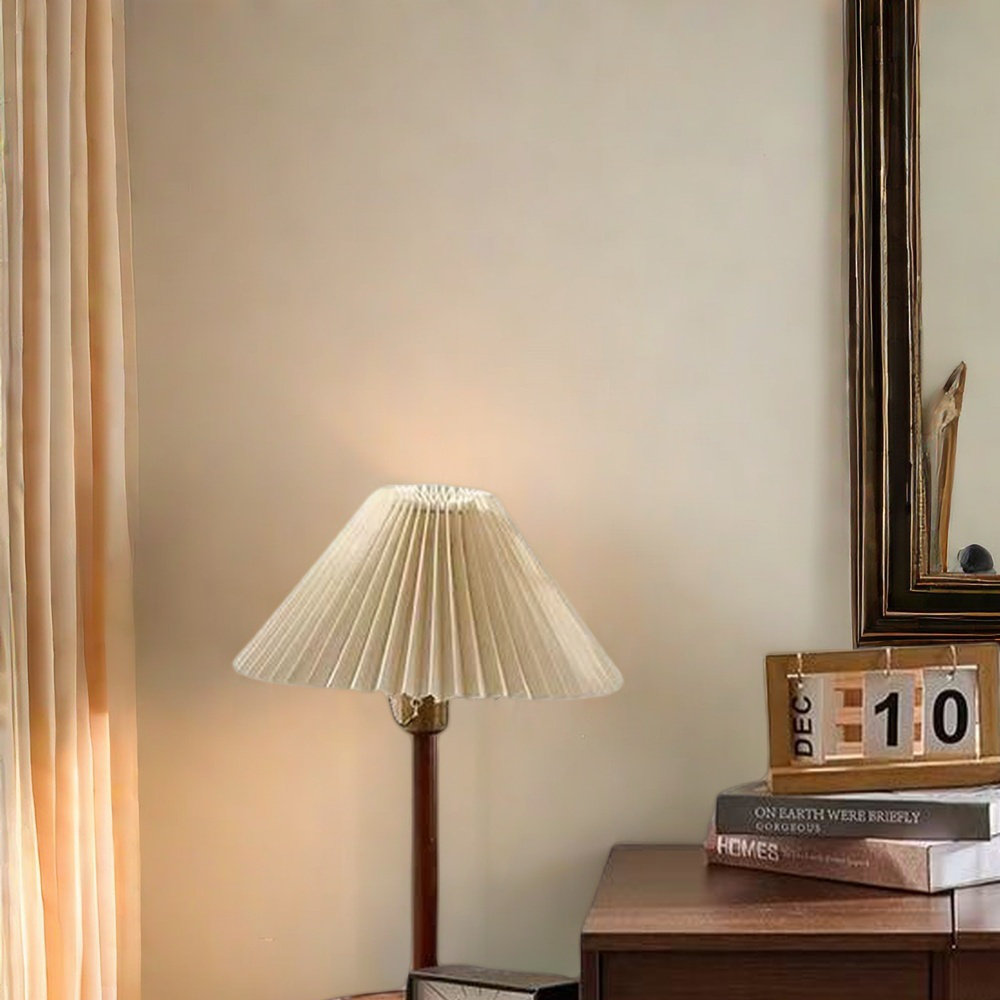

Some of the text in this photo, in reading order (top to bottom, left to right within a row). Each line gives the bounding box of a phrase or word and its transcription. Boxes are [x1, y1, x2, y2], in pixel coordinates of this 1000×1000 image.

[792, 695, 813, 758] DEC
[754, 806, 921, 825] ON EARTH WERE BRIEFLY
[755, 821, 822, 834] GORGEOUS
[716, 835, 779, 862] HOMES
